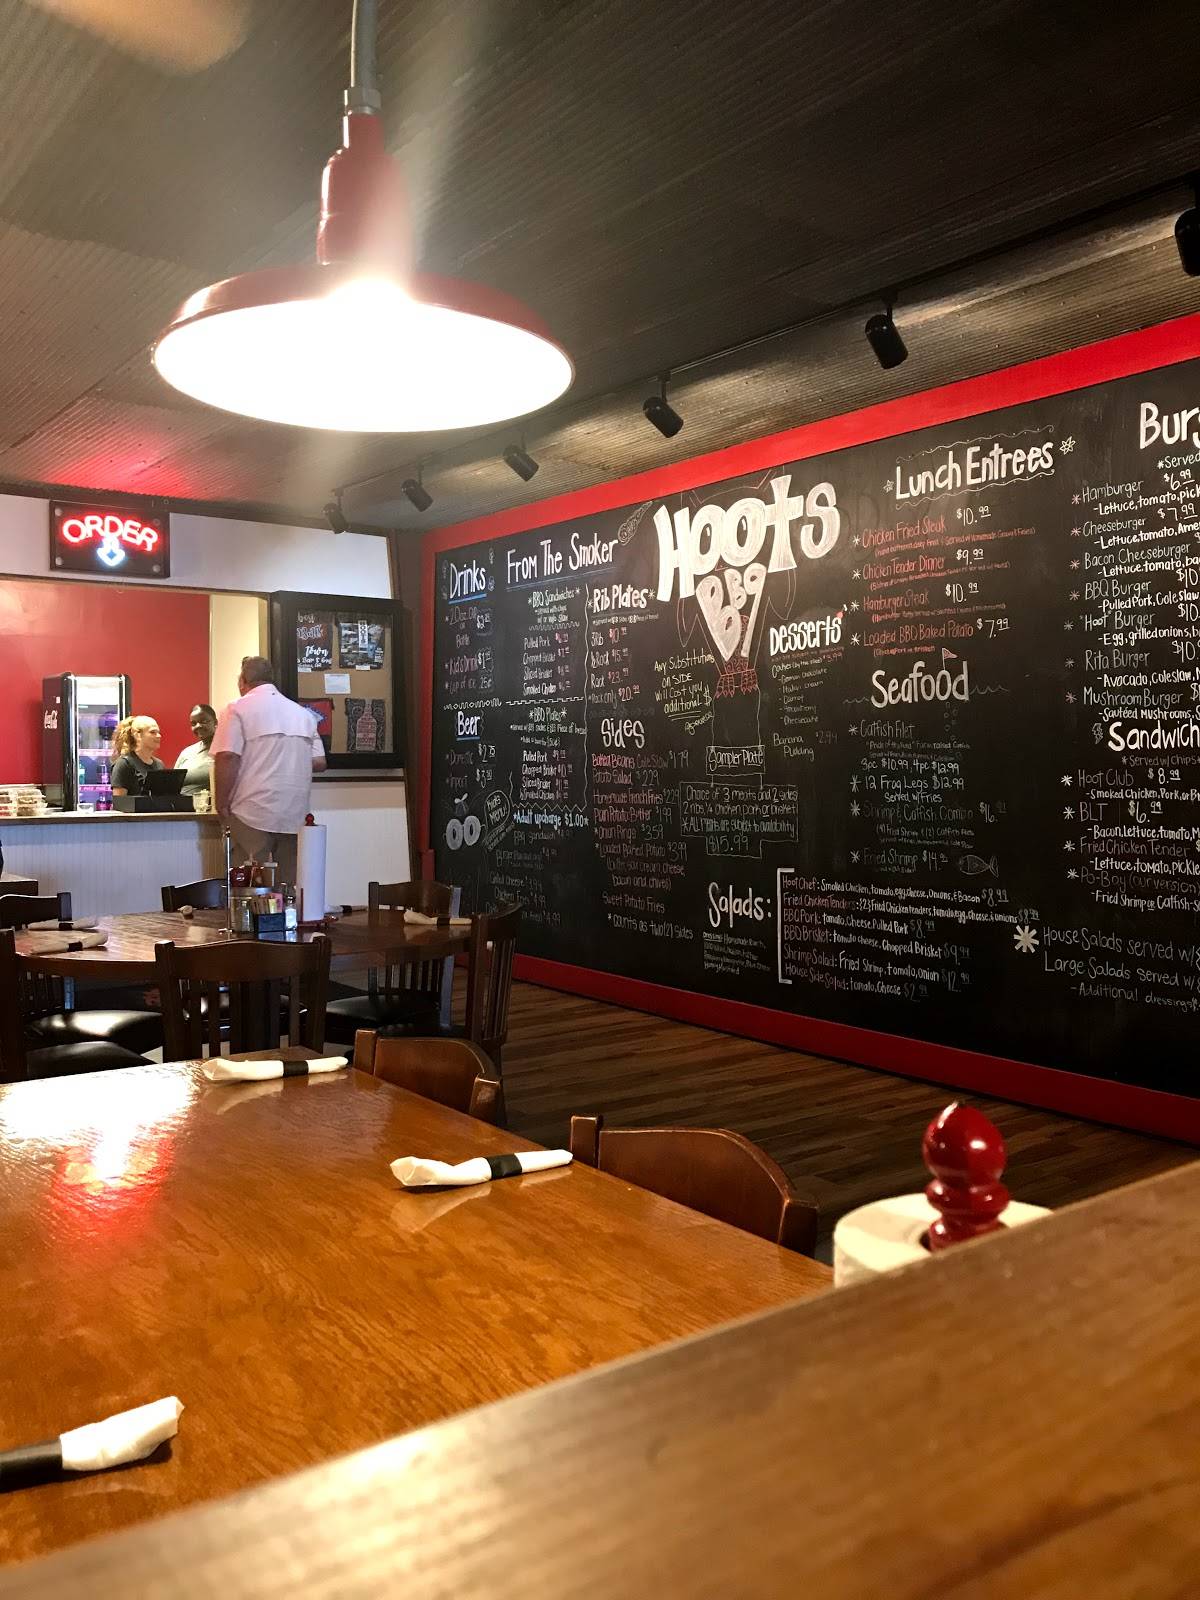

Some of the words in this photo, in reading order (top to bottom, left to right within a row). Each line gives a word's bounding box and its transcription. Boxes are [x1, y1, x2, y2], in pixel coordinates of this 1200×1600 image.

[896, 450, 962, 500] Lunch
[966, 442, 1054, 486] Entrees
[1082, 480, 1144, 503] Hamburger
[63, 515, 160, 552] ORDER
[861, 526, 895, 548] Chicken
[896, 520, 921, 538] Fried
[1083, 518, 1147, 537] Cheeseburger
[507, 549, 538, 583] From
[540, 540, 562, 577] The
[568, 533, 619, 577] Smoker
[1085, 552, 1115, 570] Bacon
[1118, 543, 1191, 564] Cheeseburger
[450, 560, 487, 598] Drinks
[863, 561, 892, 580] Chicken
[593, 588, 610, 613] Rib
[611, 584, 648, 611] Plates
[945, 582, 979, 603] $10.99
[1085, 579, 1109, 601] BBQ
[1112, 579, 1152, 599] Burger
[863, 594, 903, 614] Hamburger
[863, 631, 896, 646] Loaded
[919, 624, 946, 640] Baked
[947, 620, 974, 638] Potato
[976, 618, 1011, 639] $7.99
[1114, 609, 1155, 633] Burger
[769, 616, 842, 657] Desserts
[1085, 649, 1110, 671] Rita
[1113, 649, 1151, 669] Burger
[872, 660, 969, 708] Seafood
[1083, 686, 1141, 706] Mushroom
[1142, 687, 1183, 709] Burger
[457, 711, 480, 736] Beer
[601, 718, 646, 749] Sides
[860, 720, 895, 740] Catfish
[773, 733, 804, 746] Banana
[709, 751, 741, 772] Sampler
[784, 745, 815, 762] Pudding
[865, 775, 877, 790] 12
[880, 775, 903, 794] Frog
[904, 775, 929, 794] Legs
[1105, 768, 1134, 786] Club
[1079, 801, 1108, 821] BLT
[709, 834, 750, 852] $15.99
[1079, 836, 1105, 854] Fried
[1105, 838, 1146, 856] Chicken
[1146, 839, 1190, 857] Tender
[709, 881, 771, 929] Salads:
[882, 939, 914, 956] Chopped
[915, 941, 943, 959] Brisket
[1043, 926, 1081, 947] House
[1081, 927, 1122, 953] Salads
[1044, 950, 1084, 977] Large
[1087, 956, 1132, 979] Salads
[1137, 967, 1179, 986] Served
